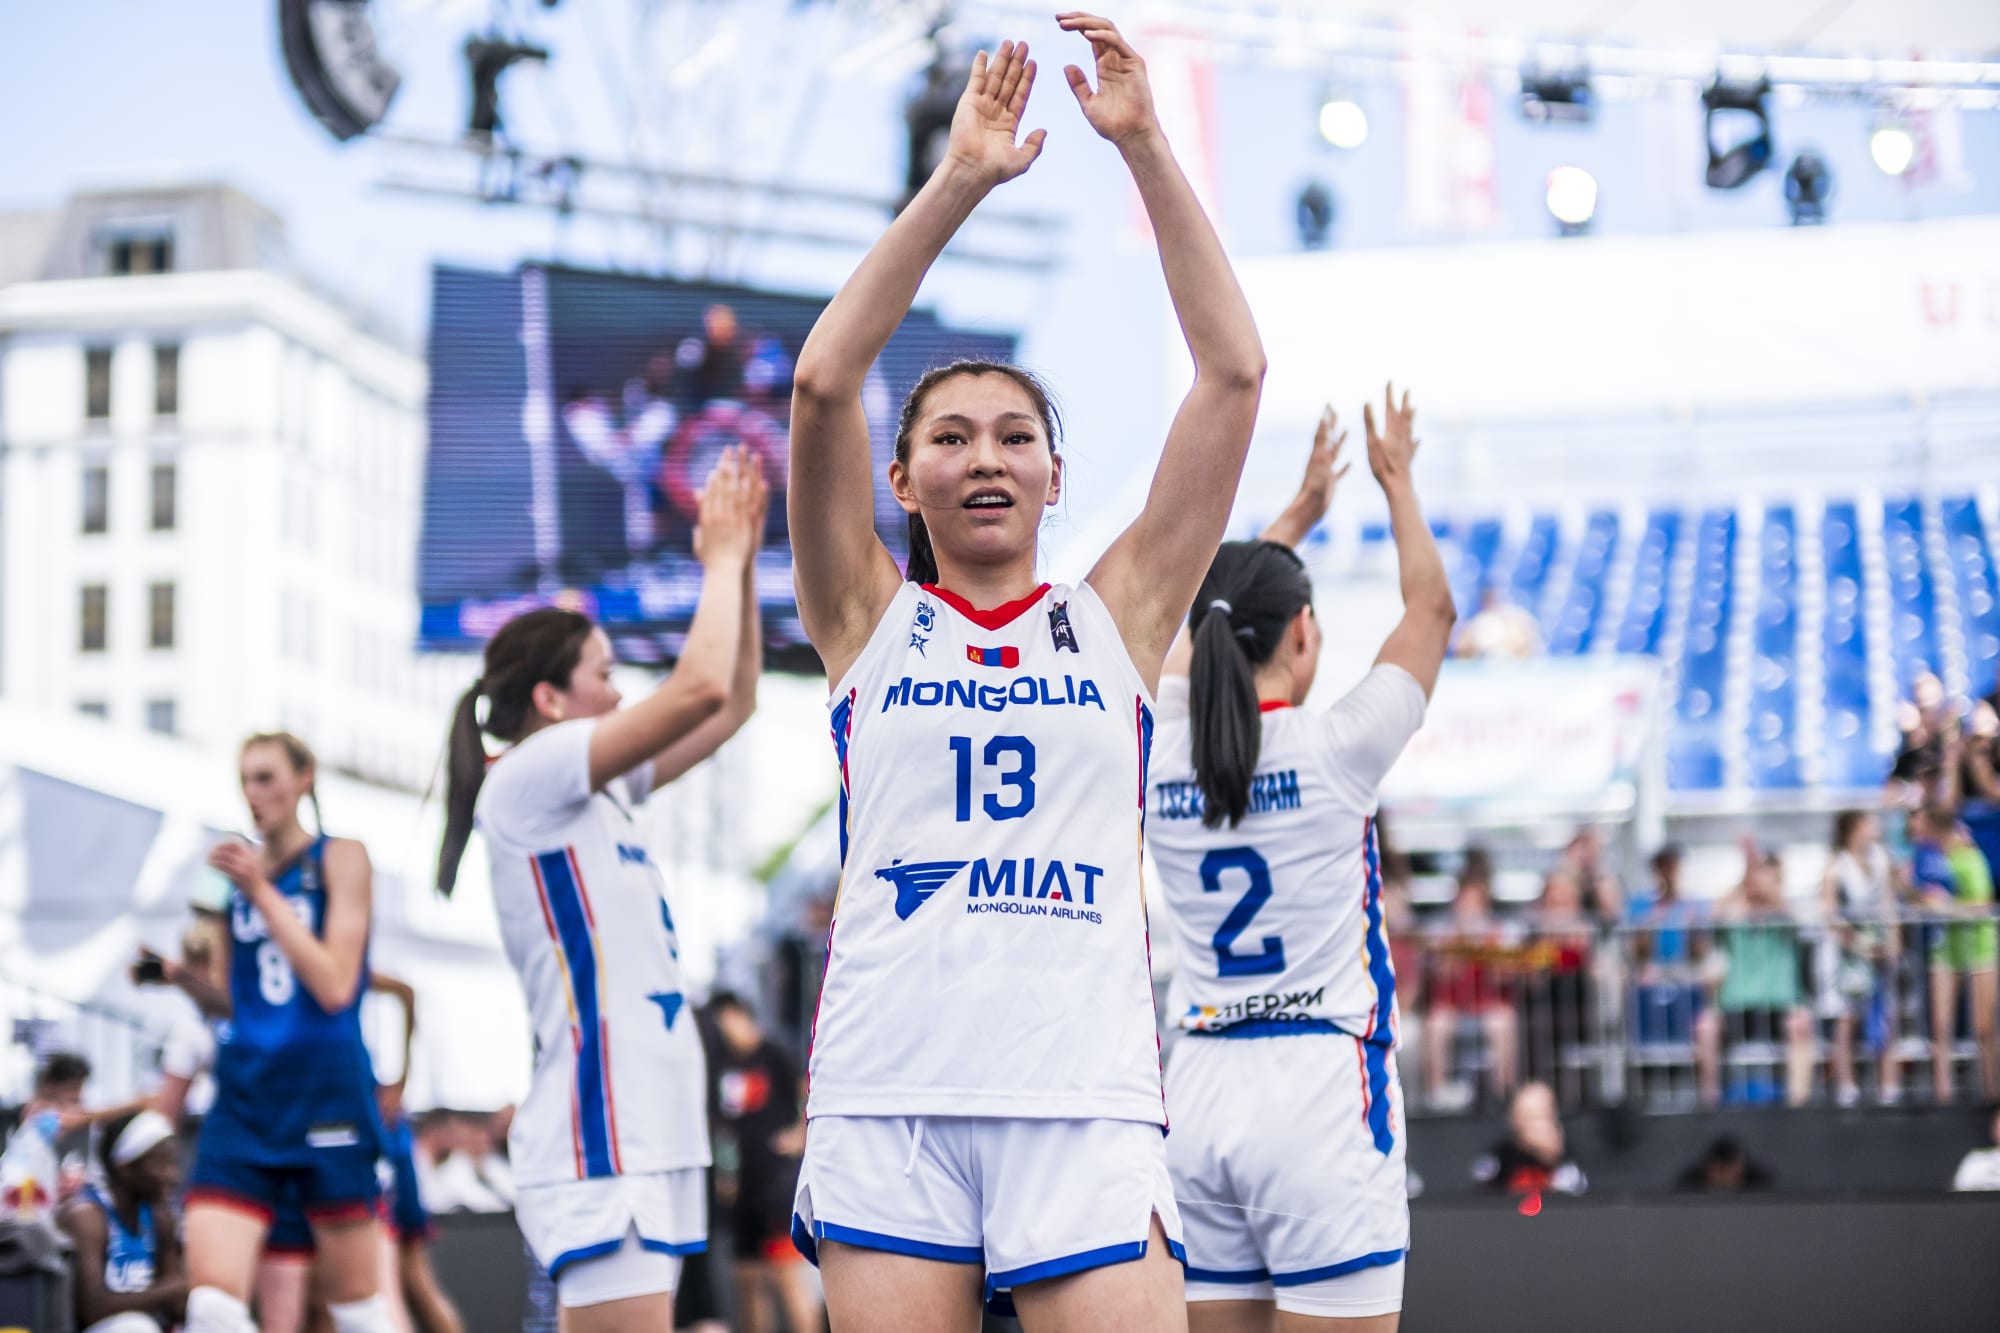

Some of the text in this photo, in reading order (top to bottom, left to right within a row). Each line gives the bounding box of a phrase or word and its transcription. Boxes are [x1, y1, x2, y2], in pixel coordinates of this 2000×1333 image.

[881, 674, 1106, 713] MONGOLIA
[949, 735, 1036, 822] 13
[968, 857, 1104, 905] MIAT
[967, 902, 1103, 925] MONGOLIAN AIRLINES
[1199, 846, 1287, 978] 2
[255, 940, 295, 1005] 8
